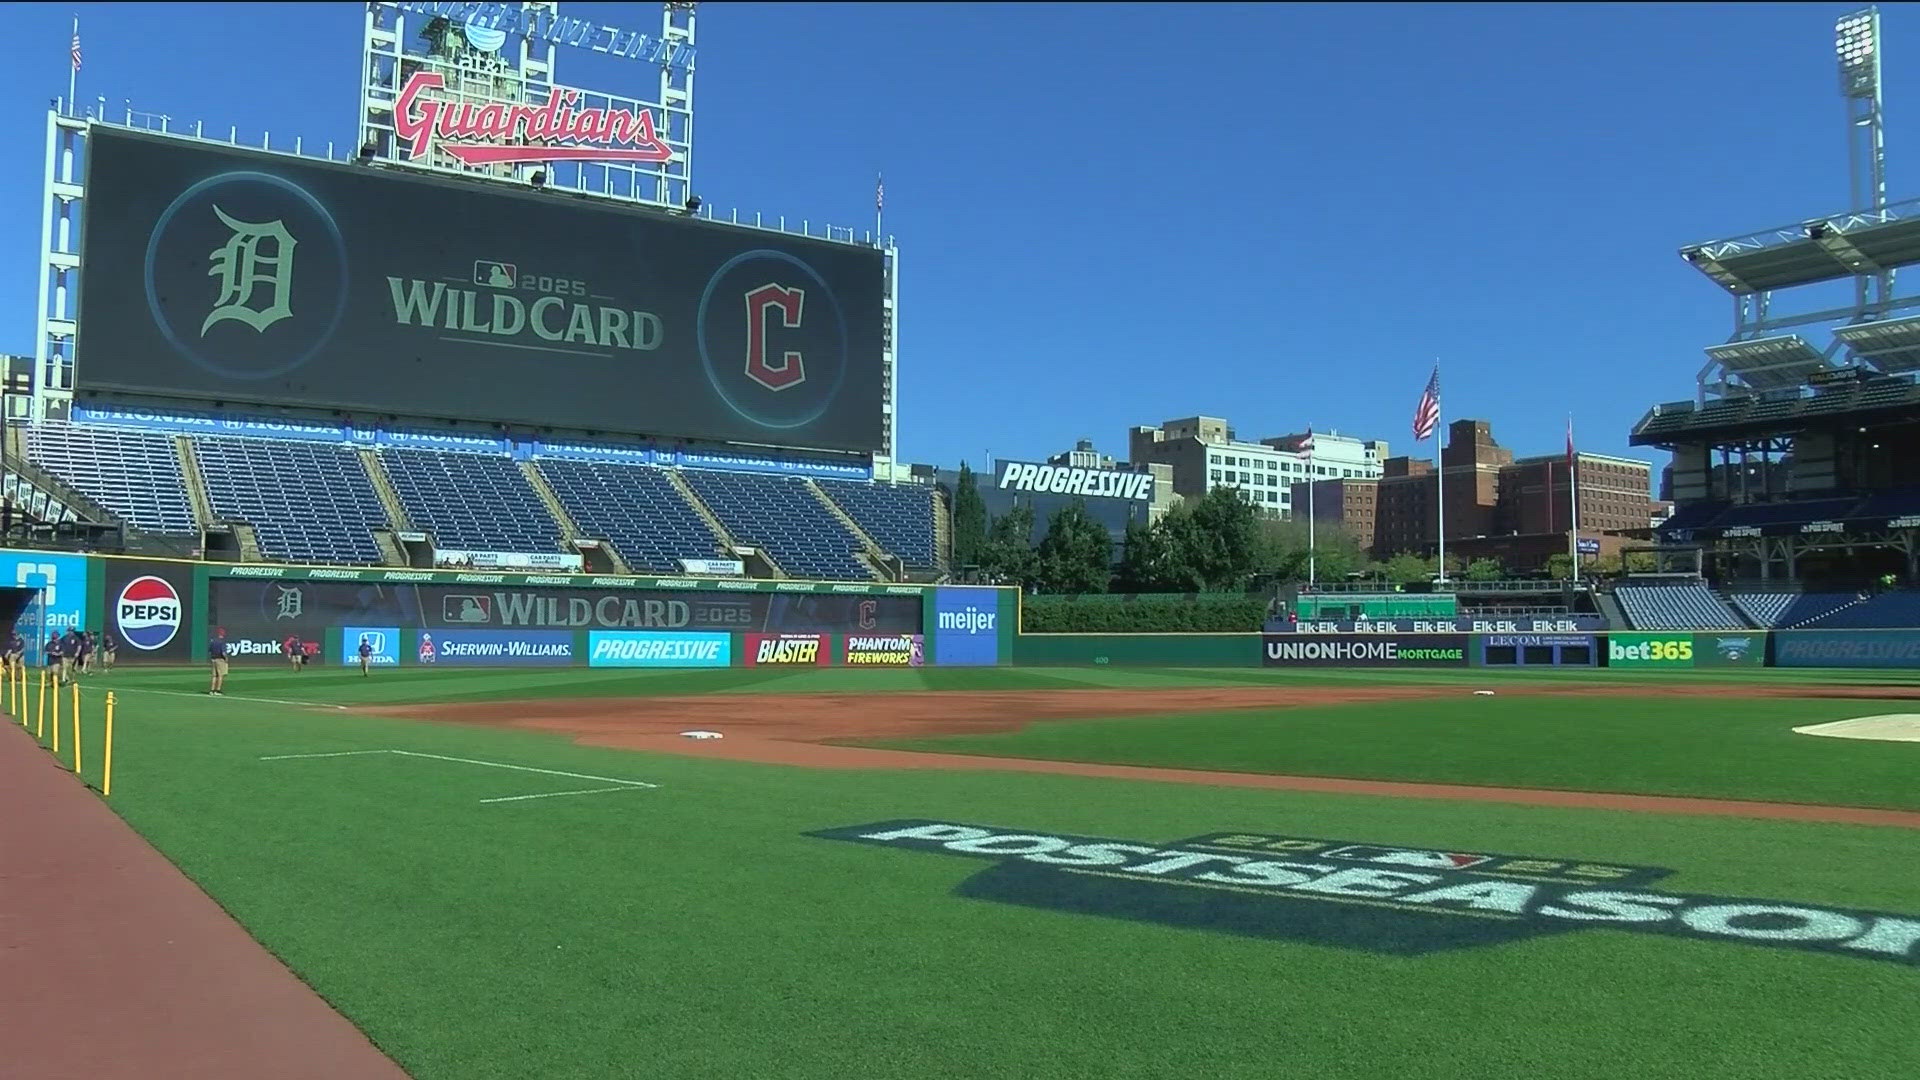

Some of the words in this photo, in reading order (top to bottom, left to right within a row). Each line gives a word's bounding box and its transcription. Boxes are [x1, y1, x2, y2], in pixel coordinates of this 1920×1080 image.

[460, 51, 508, 74] at&t
[394, 71, 668, 164] Guardians
[201, 203, 298, 338] D
[522, 275, 586, 296] 2025
[744, 282, 806, 392] C
[111, 406, 216, 426] HONDA
[246, 416, 342, 435] HONDA
[411, 428, 498, 446] HONDA
[564, 441, 644, 457] HONDA
[703, 451, 776, 467] HONDA
[799, 458, 866, 474] HONDA
[999, 462, 1155, 500] PROGRESSIVE
[230, 567, 285, 577] PROGRESSIVE
[309, 569, 361, 579] PROGRESSIVE
[384, 571, 433, 581] PROGRESSIVE
[456, 574, 503, 583] PROGRESSIVE
[525, 575, 571, 585] PROGRESSIVE
[592, 577, 637, 587] PROGRESSIVE
[656, 579, 699, 588] PROGRESSIVE
[717, 581, 758, 590] PROGRESSIVE
[776, 583, 815, 591] PROGRESSIVE
[832, 585, 871, 593] PROGRESSIVE
[886, 586, 924, 595] PROGRESSIVE
[121, 604, 177, 621] PEPSI
[694, 607, 752, 623] 2025
[859, 600, 876, 630] C
[939, 606, 996, 634] meijer
[226, 639, 282, 657] eyBank
[848, 637, 911, 651] PHANTOM
[1490, 636, 1541, 646] LECOM
[593, 639, 721, 660] PROGRESSIVE
[757, 639, 820, 664] BLASTER
[1398, 649, 1462, 660] MORTGAGE
[1609, 641, 1694, 661] bet365
[348, 656, 395, 664] HNDA
[847, 652, 910, 664] FIREWORKS
[1094, 656, 1109, 664] 400
